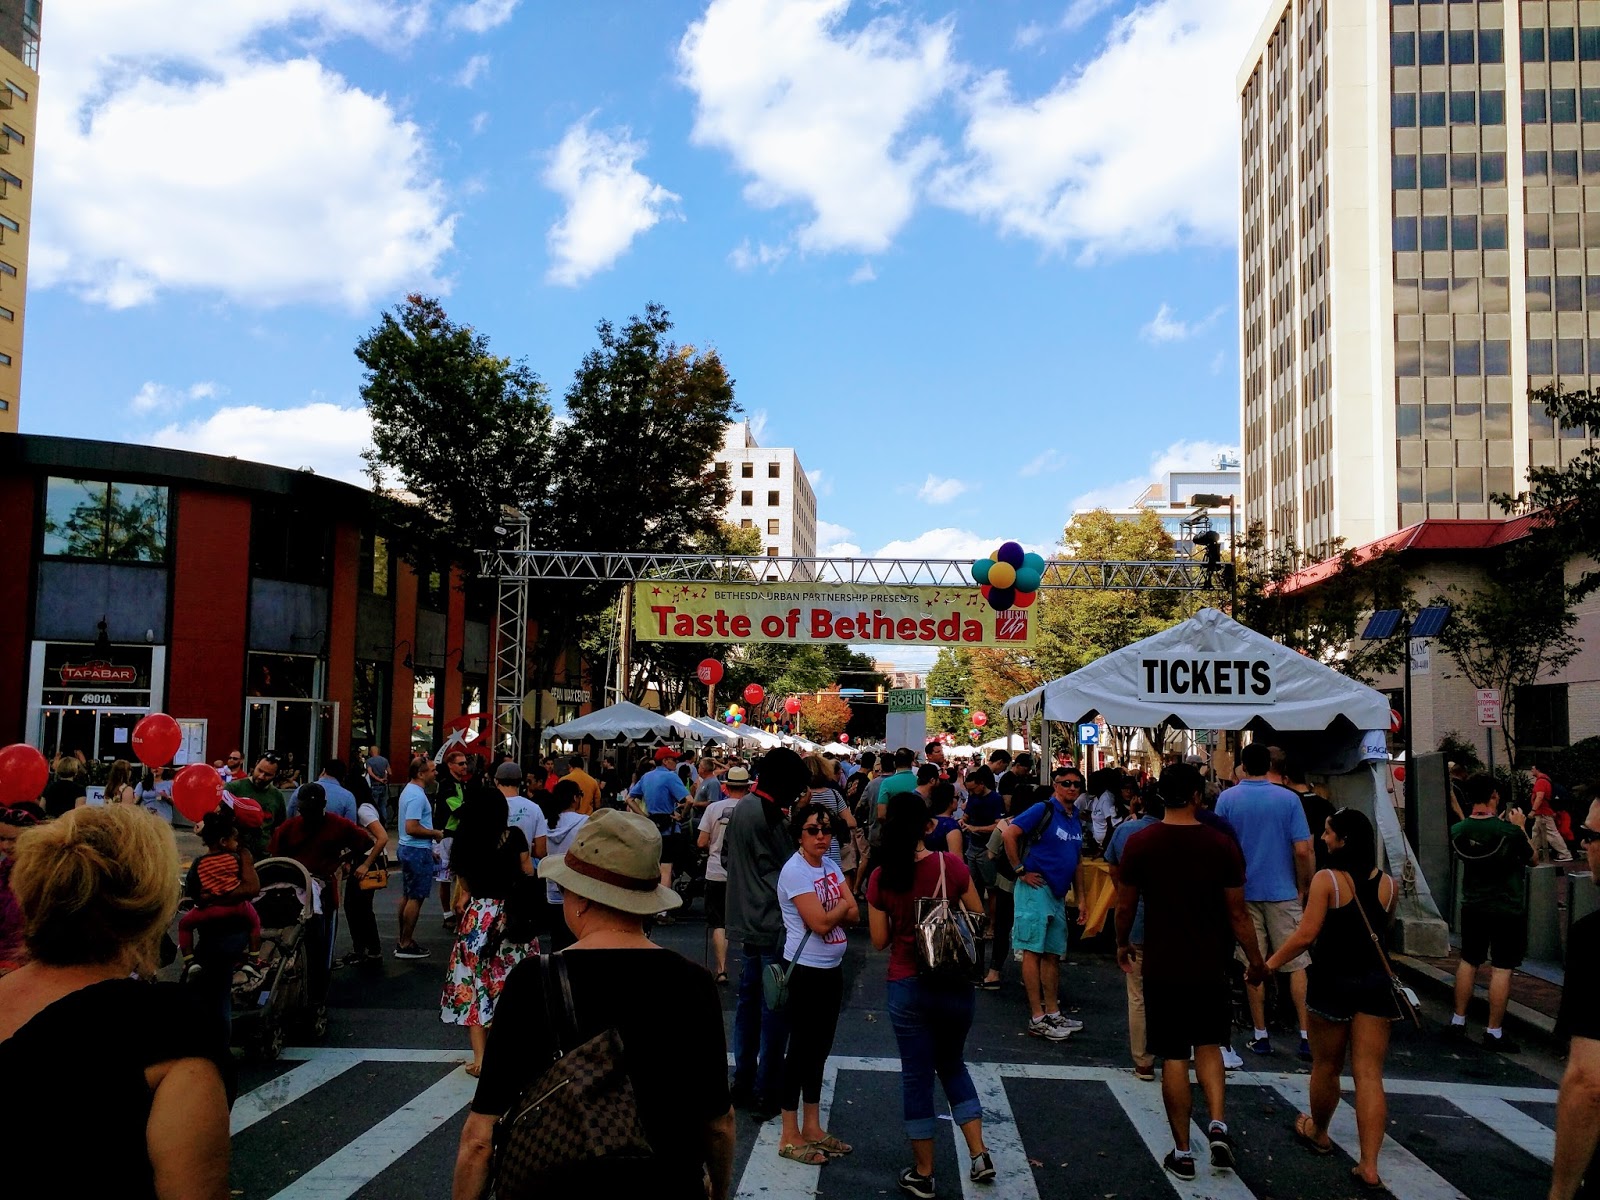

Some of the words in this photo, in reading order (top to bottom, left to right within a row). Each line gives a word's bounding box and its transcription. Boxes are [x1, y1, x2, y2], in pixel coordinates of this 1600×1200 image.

[714, 591, 764, 600] BETHESDA
[766, 592, 800, 601] URBAN
[802, 593, 868, 603] PARTNERSHIP
[870, 594, 919, 603] PRESENTS
[651, 606, 752, 637] Taste
[761, 608, 801, 638] of
[810, 609, 984, 642] Bethesda
[1411, 641, 1427, 656] EASE
[1142, 659, 1271, 696] TICKETS
[81, 694, 112, 704] 4901A
[890, 694, 925, 706] ROBIN
[1081, 726, 1095, 741] P
